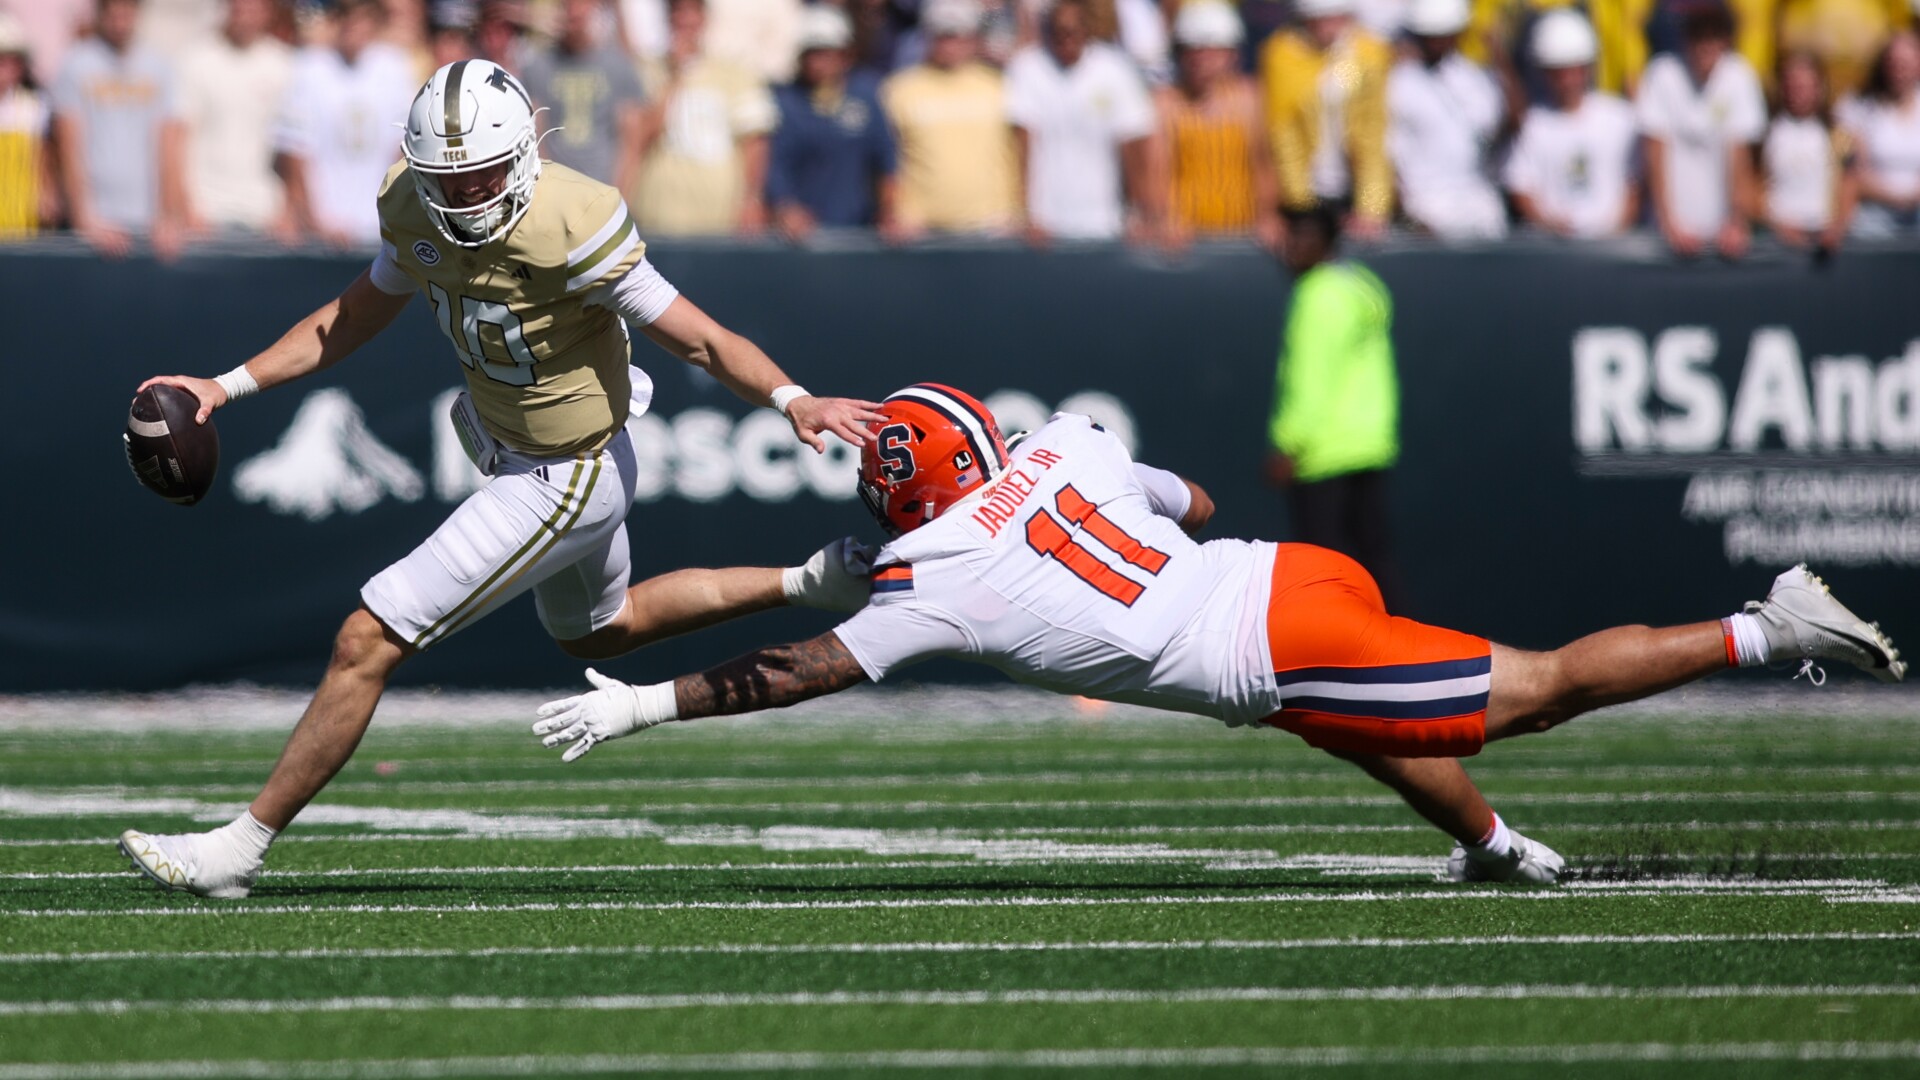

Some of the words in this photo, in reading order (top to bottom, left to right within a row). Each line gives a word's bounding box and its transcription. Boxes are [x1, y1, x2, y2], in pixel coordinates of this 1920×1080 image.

[443, 149, 468, 162] TECH
[417, 246, 436, 257] ACC
[428, 280, 540, 387] 10
[877, 423, 916, 483] S
[955, 451, 973, 470] AJ
[1026, 448, 1063, 471] JR
[1025, 481, 1172, 608] 11
